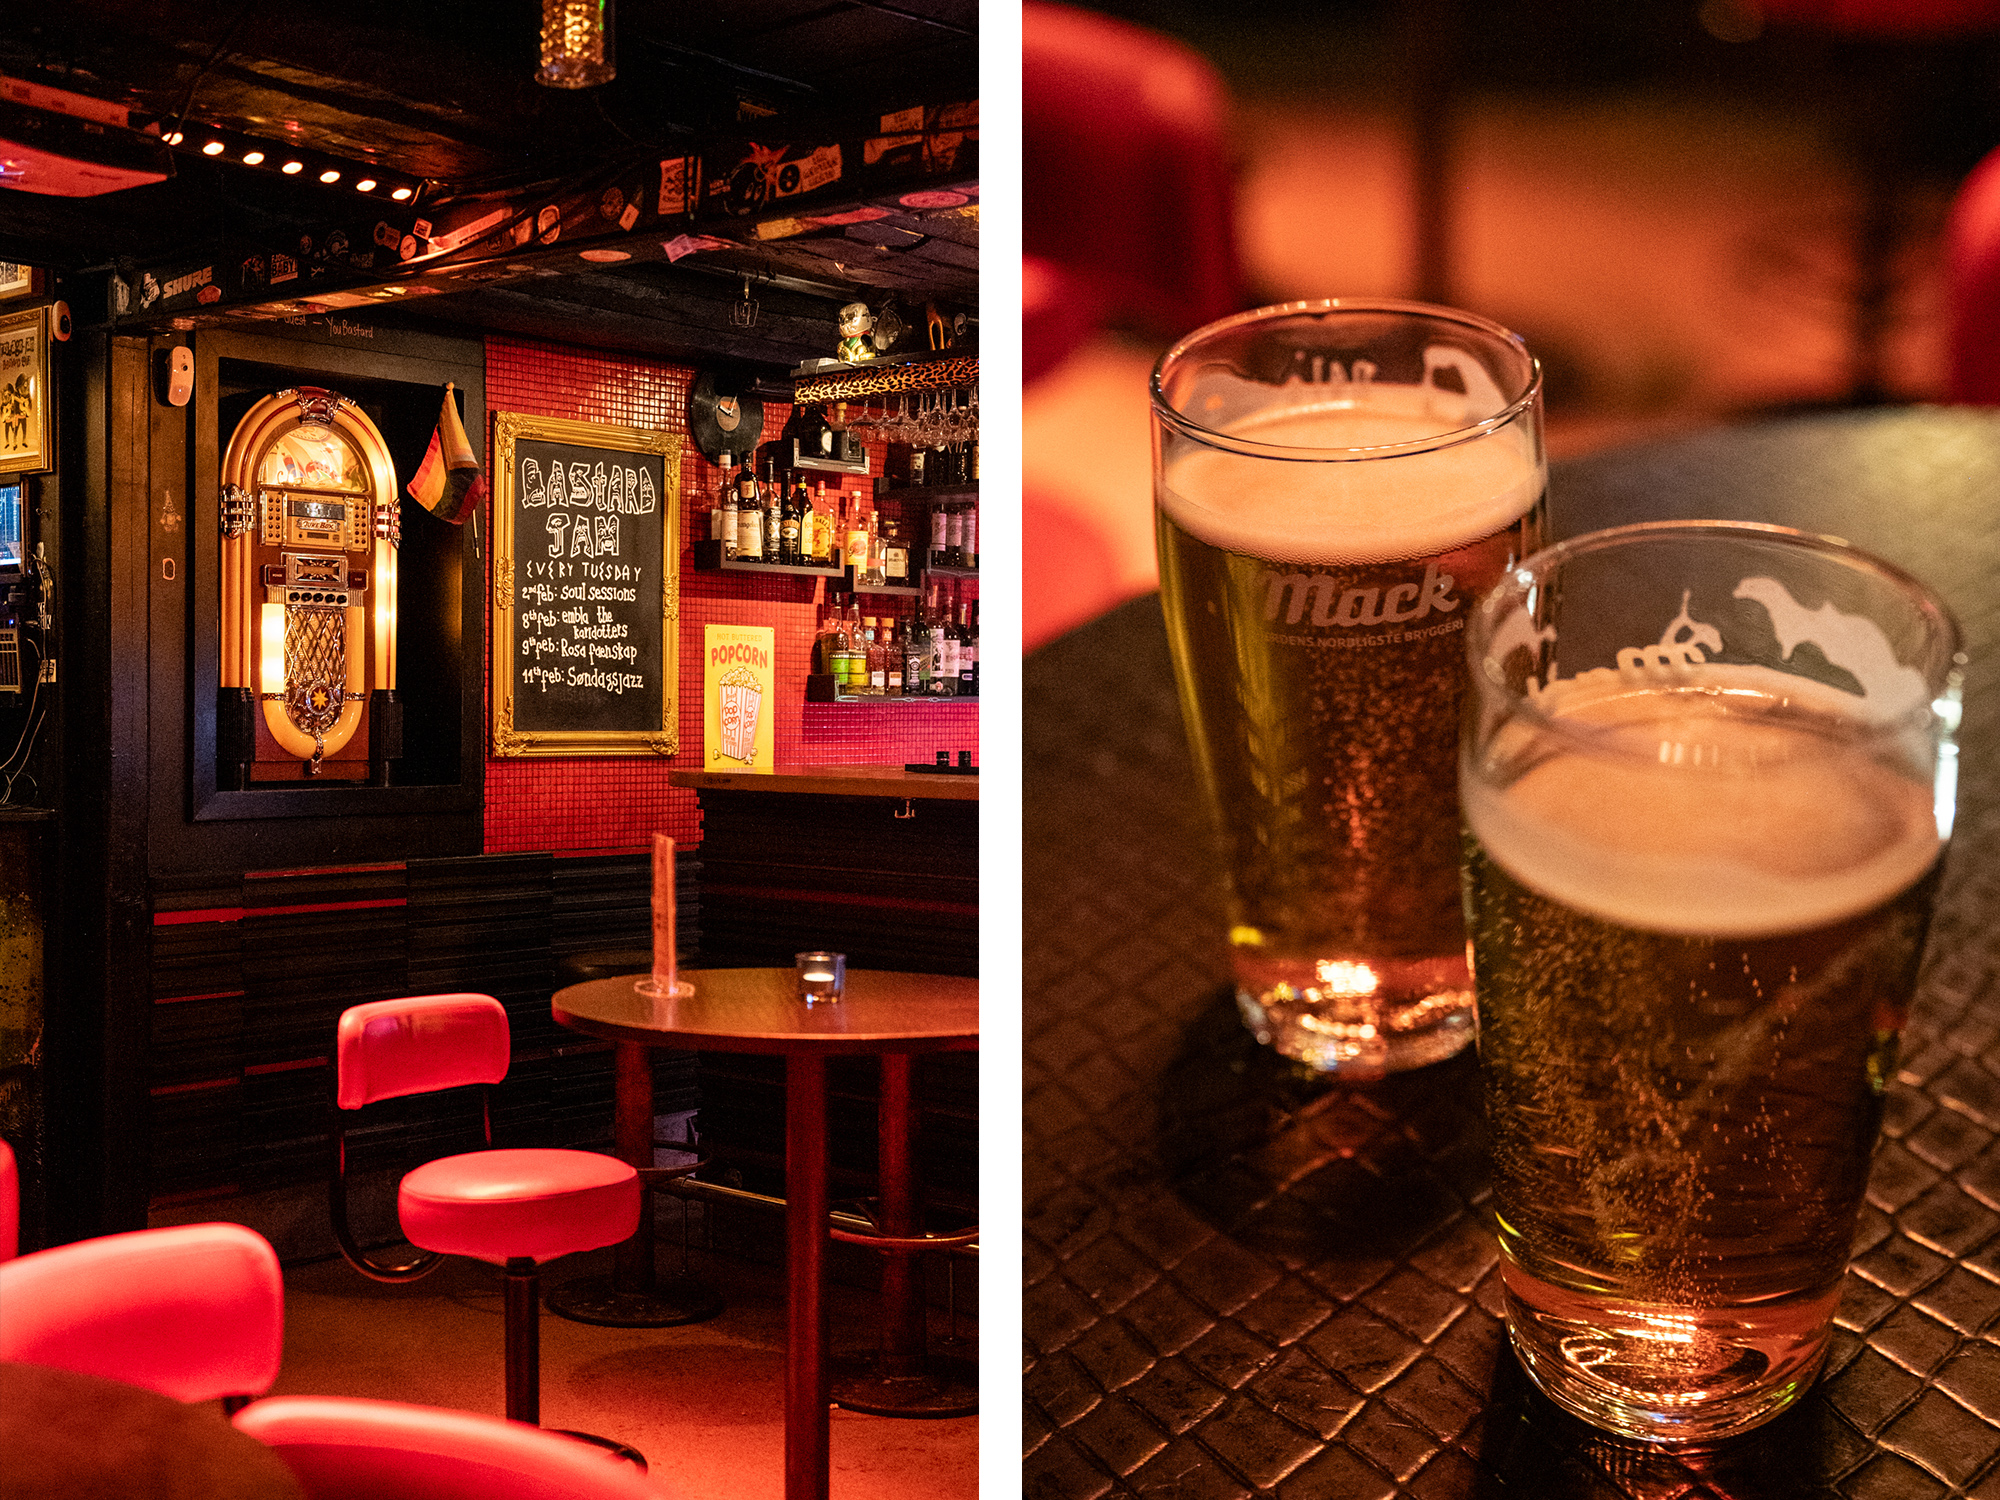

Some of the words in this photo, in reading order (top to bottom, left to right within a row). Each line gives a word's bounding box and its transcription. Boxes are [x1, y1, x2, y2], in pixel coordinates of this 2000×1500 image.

[163, 266, 213, 300] SHURE
[546, 512, 620, 559] JAM
[526, 560, 573, 580] EVERY
[581, 561, 642, 582] TUESDAY
[560, 582, 586, 601] soul
[587, 586, 636, 602] sessions
[1254, 563, 1460, 627] Mack
[561, 606, 589, 625] embla
[596, 605, 614, 624] the
[731, 633, 762, 642] BUTTERED
[1317, 633, 1402, 648] NORDLIGSTE
[1404, 619, 1464, 643] BRYGGERI
[561, 638, 586, 657] Rosa
[589, 642, 637, 665] faenskap
[711, 642, 768, 669] POPCORN
[567, 666, 643, 694] Søndagsjazz
